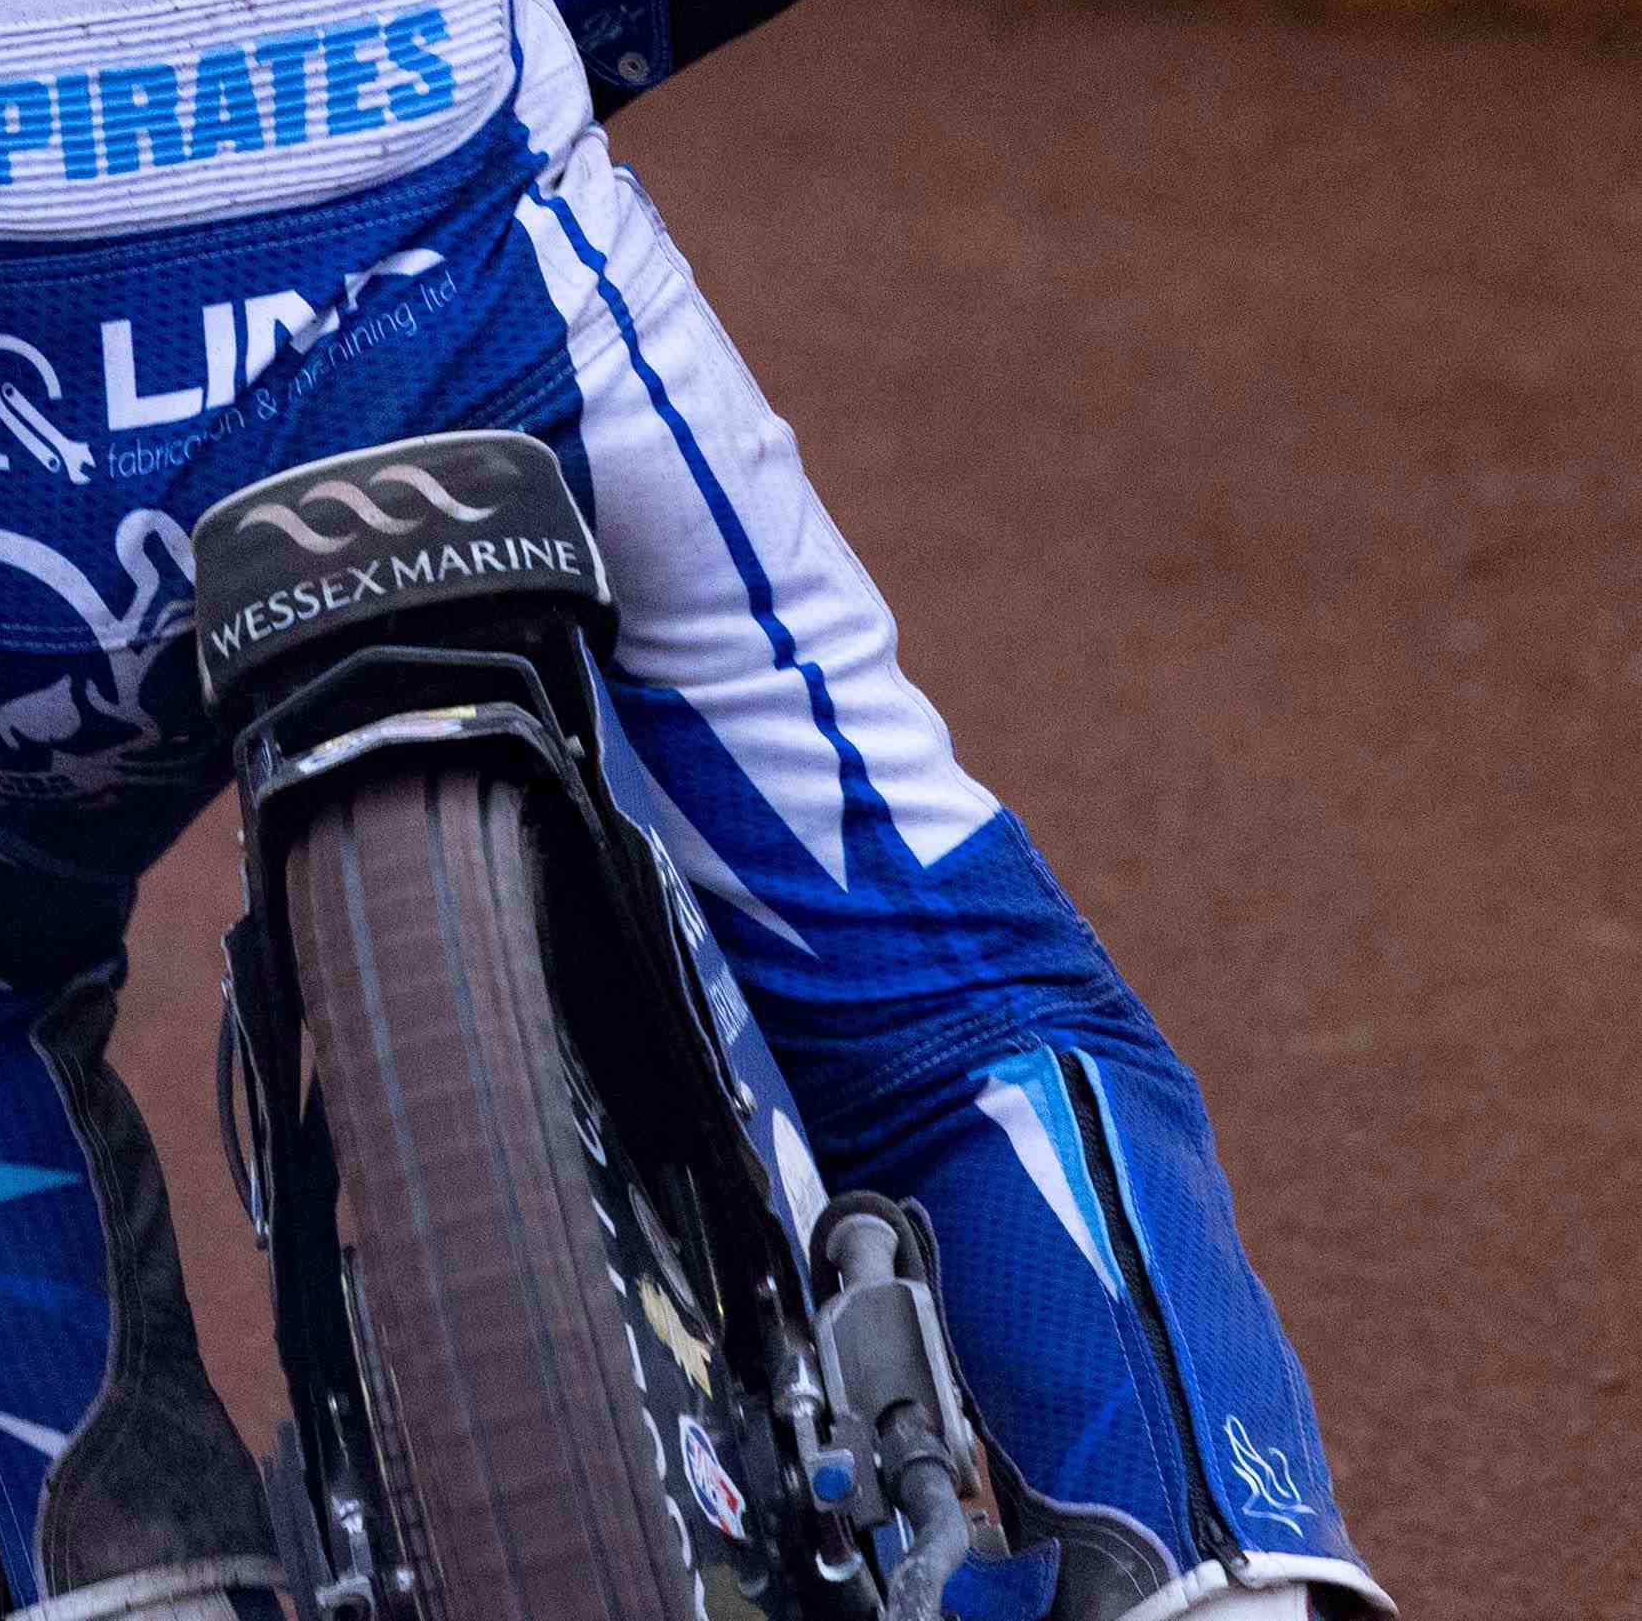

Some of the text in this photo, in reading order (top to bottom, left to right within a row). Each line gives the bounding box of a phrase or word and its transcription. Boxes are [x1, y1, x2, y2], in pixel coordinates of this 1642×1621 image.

[420, 270, 459, 313] ltd
[210, 535, 582, 660] WESSEX MARINE
